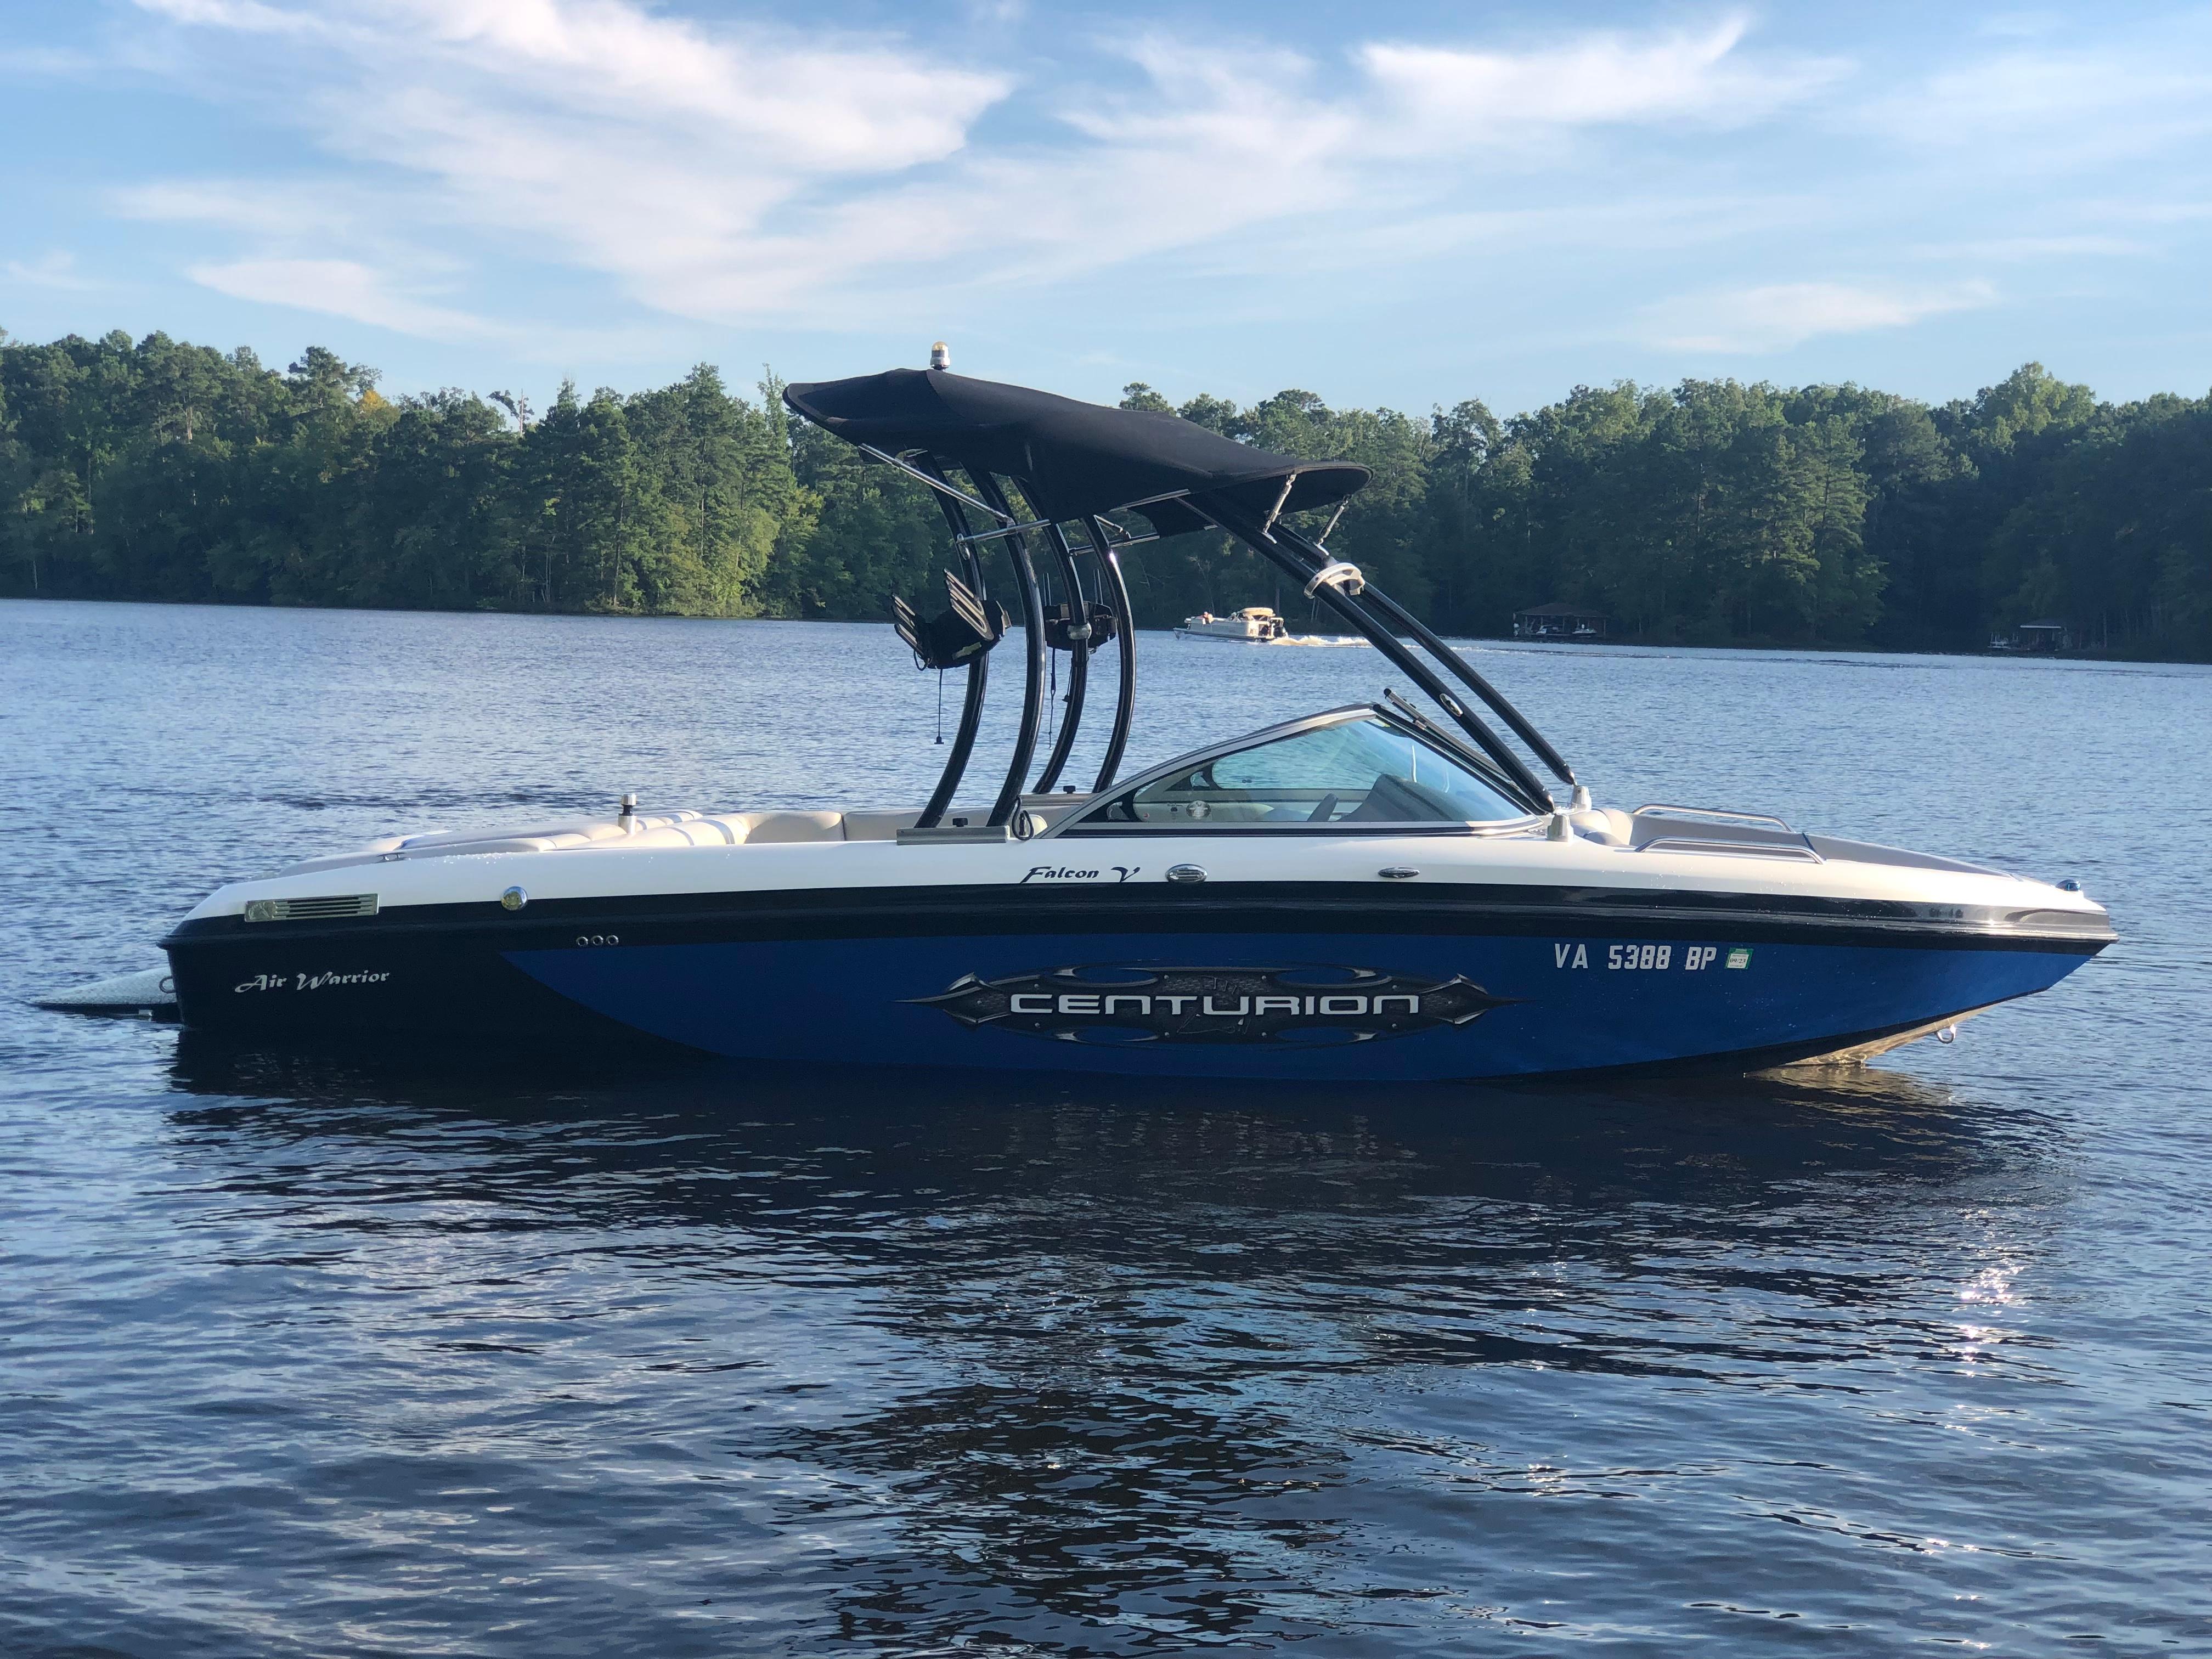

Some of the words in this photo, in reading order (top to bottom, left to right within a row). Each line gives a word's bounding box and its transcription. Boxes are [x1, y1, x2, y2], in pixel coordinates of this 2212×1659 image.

[1020, 866, 1099, 883] Falcon
[1111, 866, 1141, 882] V
[1554, 943, 1588, 968] VA
[1608, 945, 1672, 969] 5388
[1685, 946, 1717, 970] BP
[234, 974, 287, 992] Air
[296, 970, 390, 990] Warrior
[1010, 994, 1419, 1015] CENTURION
